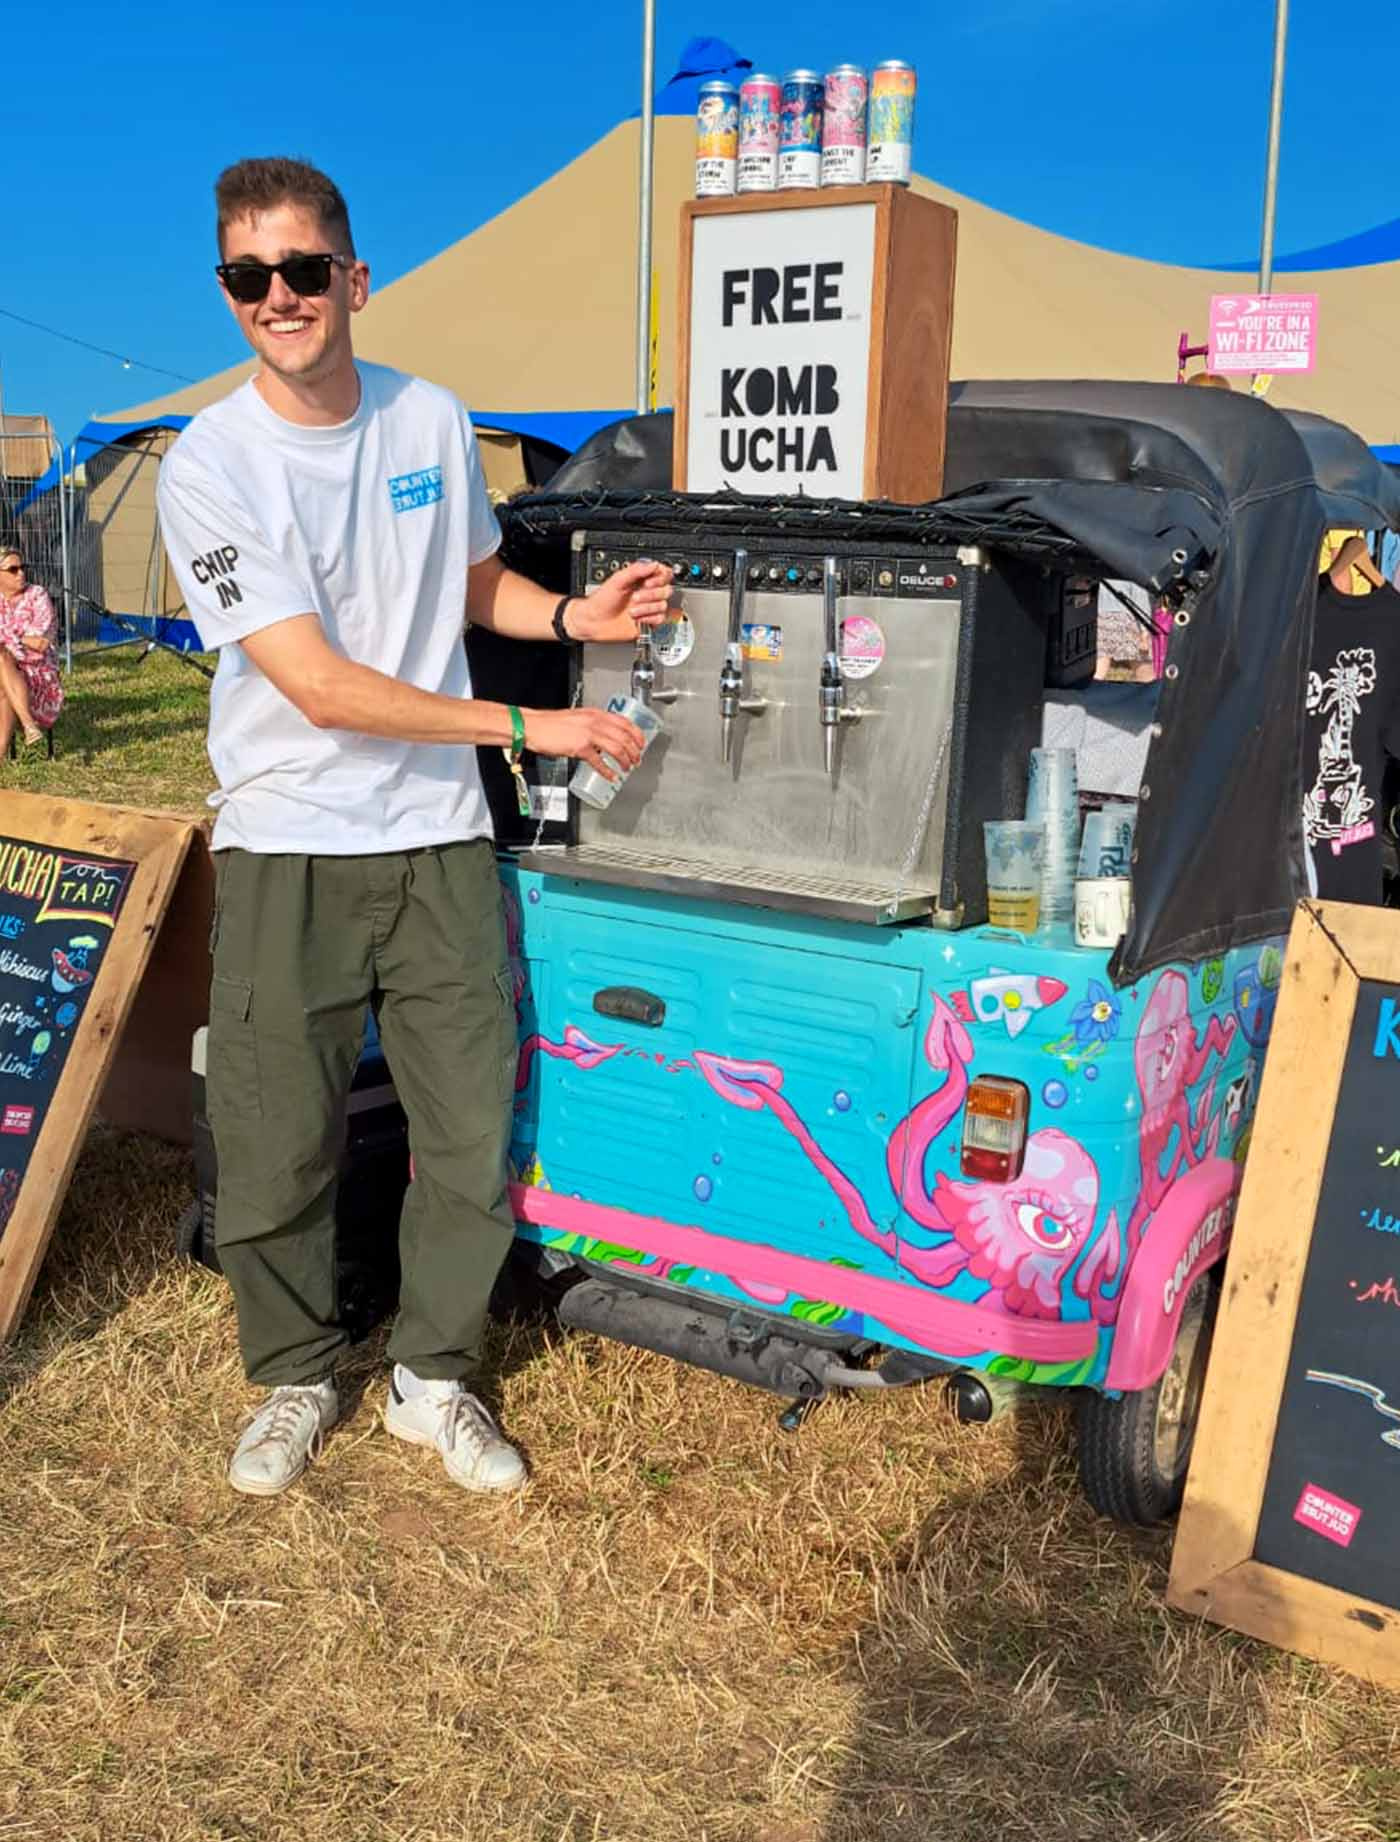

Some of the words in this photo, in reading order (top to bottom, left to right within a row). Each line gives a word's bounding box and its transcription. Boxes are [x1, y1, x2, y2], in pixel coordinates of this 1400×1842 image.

[722, 262, 843, 327] FREE
[1238, 314, 1285, 331] YOU'RE
[1287, 314, 1301, 331] IN
[1302, 314, 1311, 331] A
[1215, 331, 1262, 352] WI-FI
[1264, 331, 1310, 352] ZONE
[720, 364, 840, 418] KOMB
[720, 426, 838, 473] UCHA
[191, 545, 240, 585] CHIP
[900, 575, 944, 587] DEUCE
[215, 578, 243, 610] IN
[60, 881, 116, 907] TAP!
[1163, 1206, 1222, 1314] COUNTER
[1304, 1492, 1354, 1523] COUNTER
